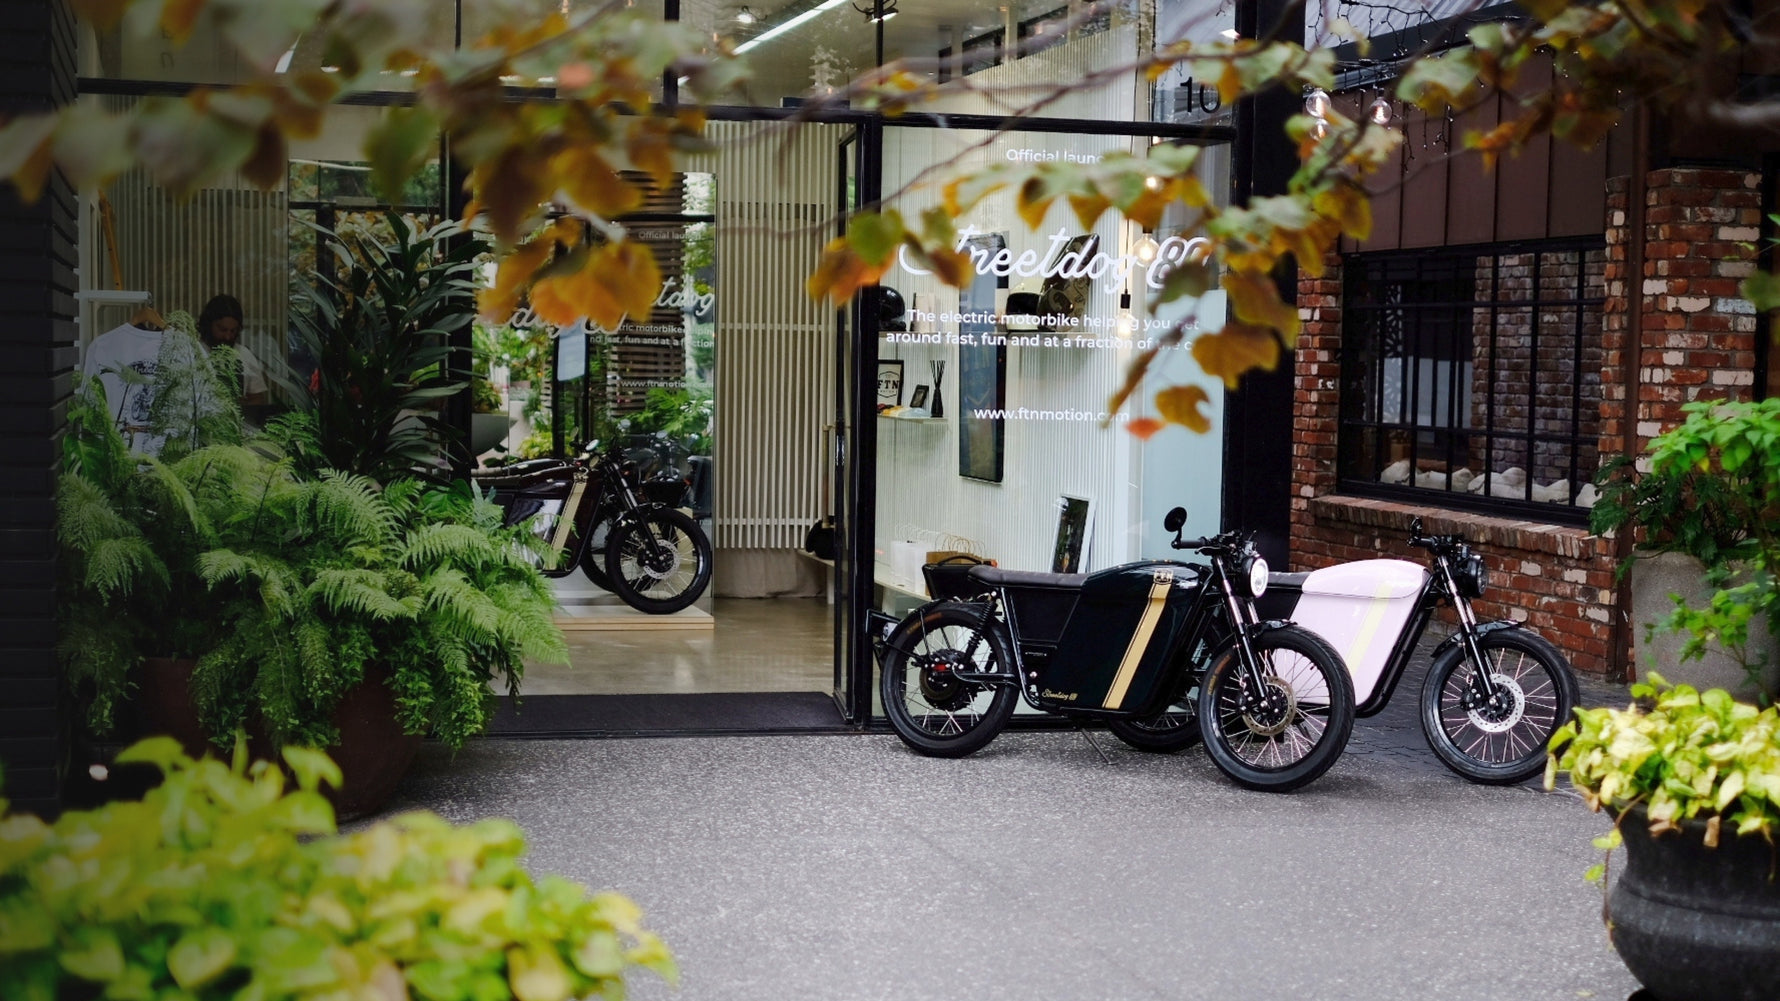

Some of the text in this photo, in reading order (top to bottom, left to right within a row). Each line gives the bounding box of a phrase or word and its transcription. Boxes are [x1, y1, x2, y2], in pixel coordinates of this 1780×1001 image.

[1179, 76, 1221, 114] 10
[1006, 149, 1059, 162] Official
[907, 309, 935, 323] The
[940, 310, 996, 324] electric
[1001, 312, 1079, 327] motorbike
[1083, 314, 1139, 332] helpg
[1143, 319, 1171, 332] you
[886, 331, 941, 344] around
[946, 332, 977, 347] fast,
[981, 332, 1007, 346] fun
[1011, 334, 1040, 347] and
[1044, 336, 1059, 348] at
[1062, 338, 1072, 348] a
[1076, 336, 1133, 350] fraction
[1137, 337, 1153, 350] of
[973, 406, 1130, 422] www.ftnmotion.cm
